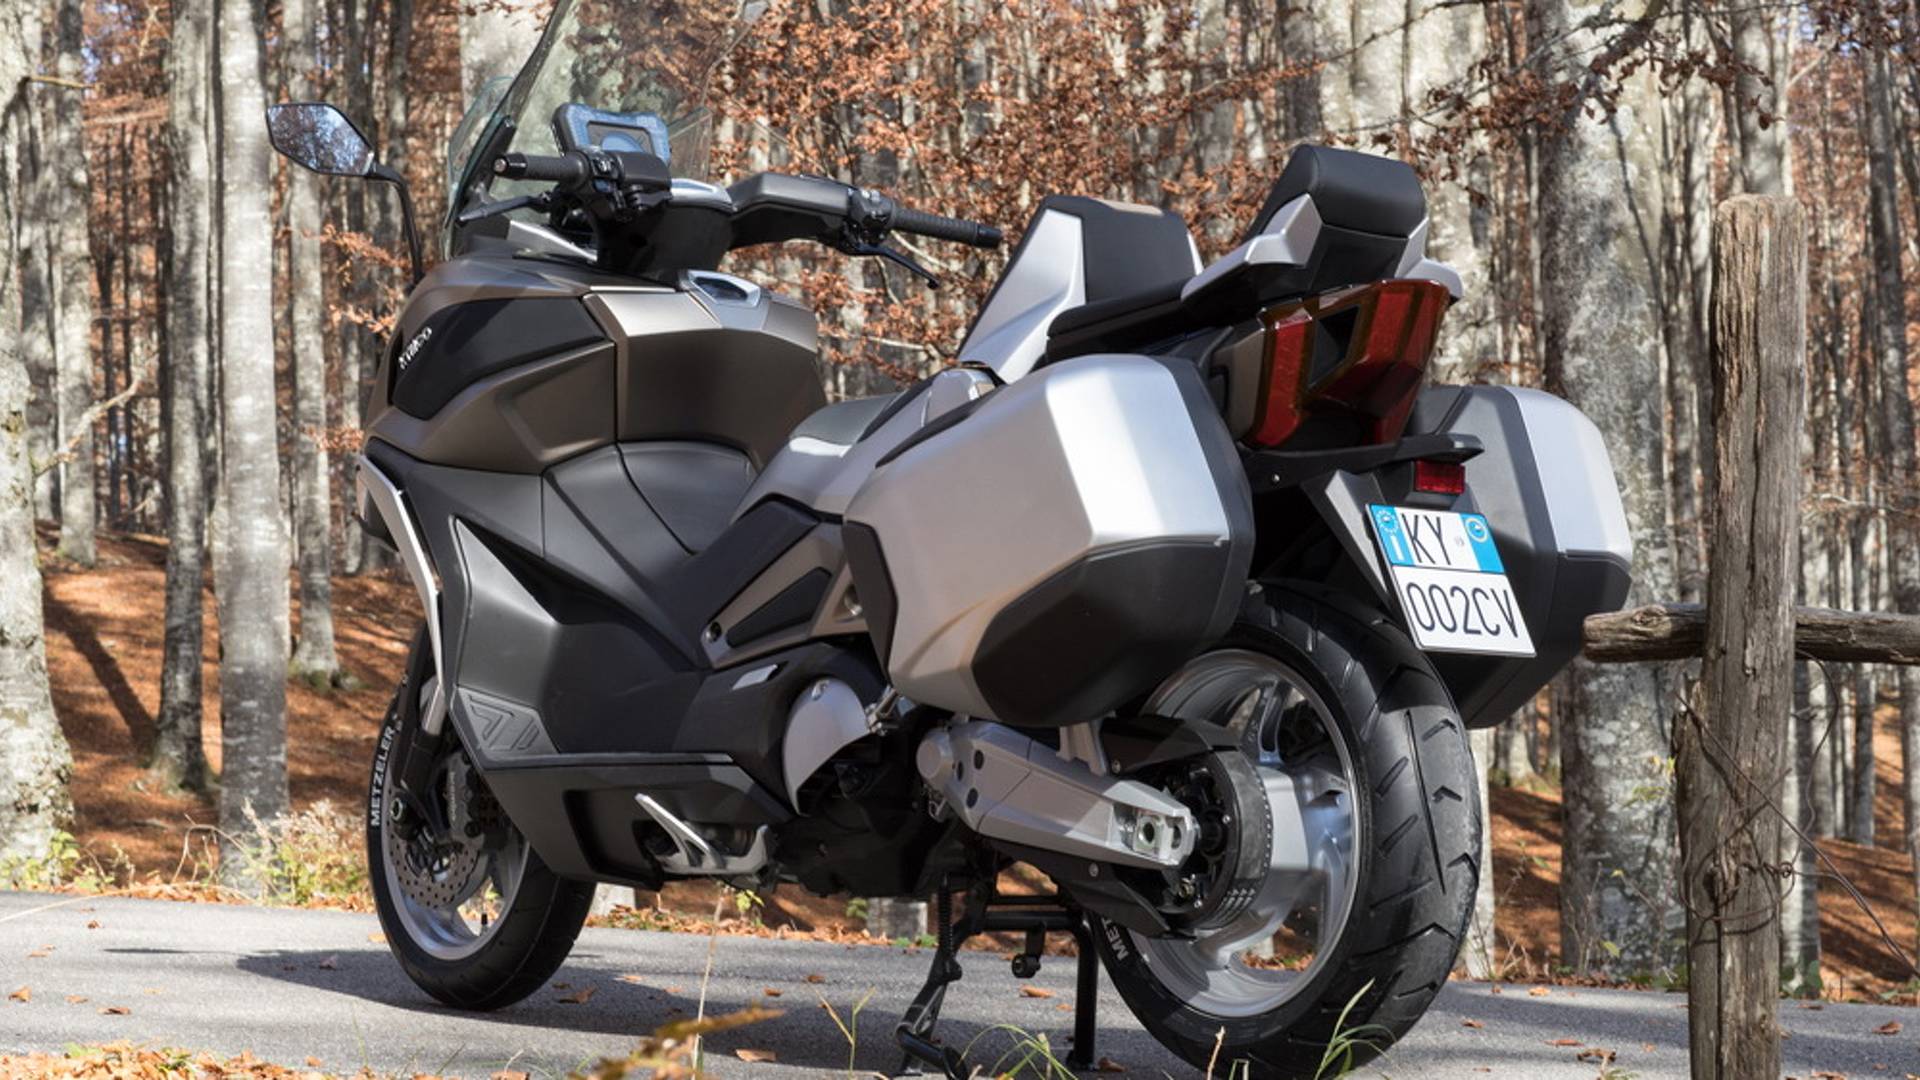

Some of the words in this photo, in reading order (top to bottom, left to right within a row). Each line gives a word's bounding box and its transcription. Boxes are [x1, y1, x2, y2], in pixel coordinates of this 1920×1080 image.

[1402, 513, 1452, 566] KY
[1406, 582, 1519, 638] 002CV
[371, 727, 396, 826] METZELER
